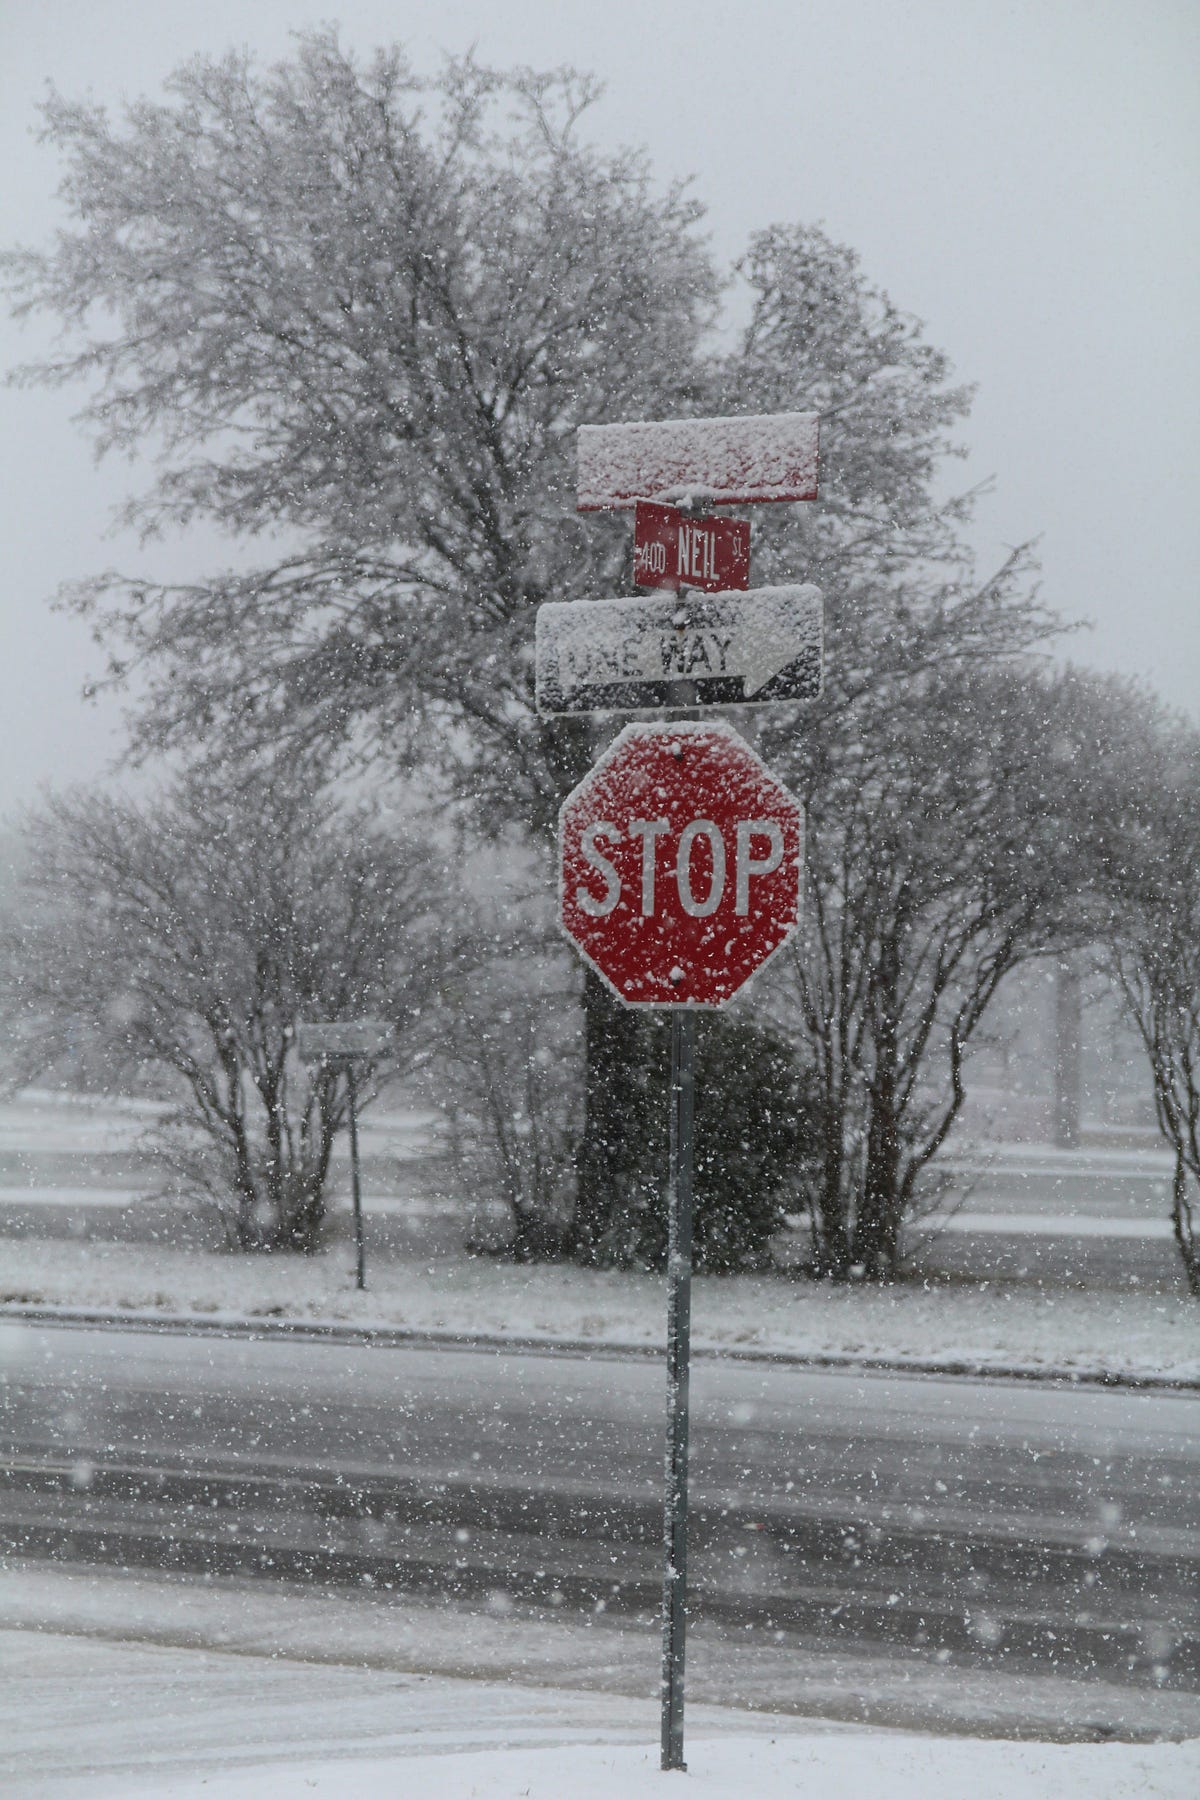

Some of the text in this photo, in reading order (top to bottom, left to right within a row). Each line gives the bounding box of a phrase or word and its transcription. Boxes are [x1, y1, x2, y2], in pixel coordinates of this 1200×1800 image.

[641, 541, 666, 574] 400
[676, 525, 720, 580] NEIL
[660, 633, 734, 673] WAY
[576, 819, 785, 917] STOP
